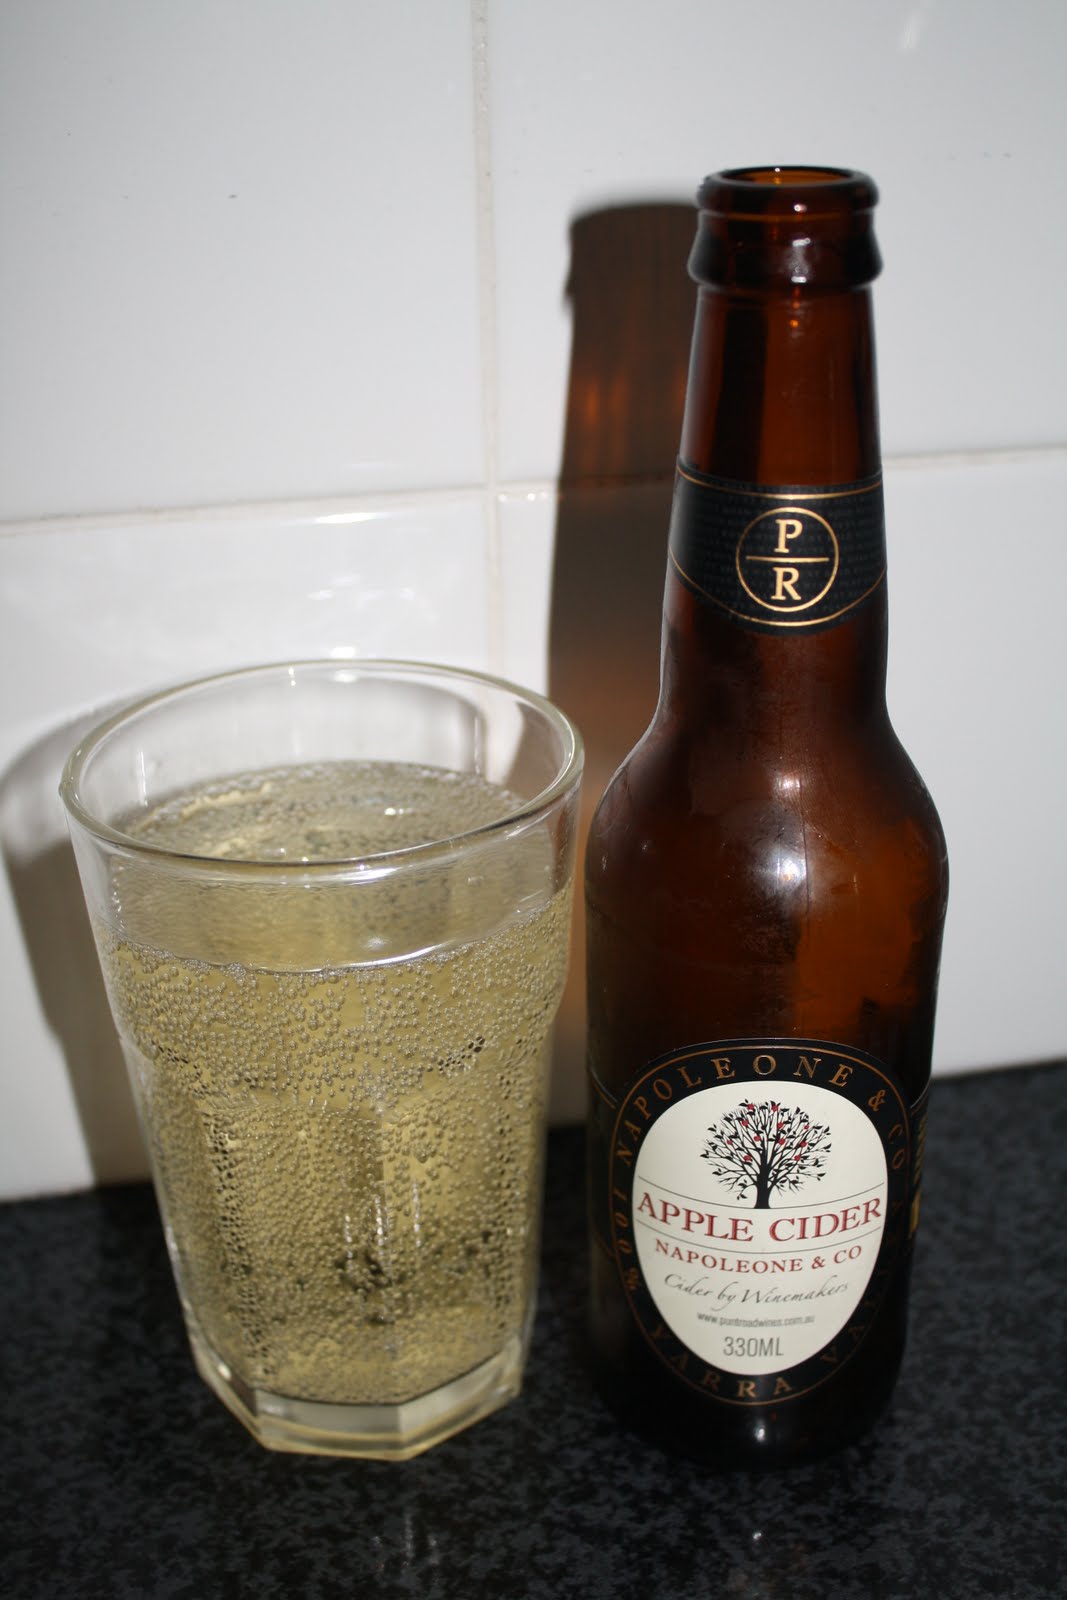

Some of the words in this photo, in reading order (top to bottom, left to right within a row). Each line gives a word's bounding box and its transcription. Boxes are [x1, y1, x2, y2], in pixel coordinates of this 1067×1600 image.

[774, 519, 803, 553] P
[771, 567, 801, 600] R
[616, 1055, 853, 1167] NAPOLEONE
[868, 1090, 886, 1112] &
[637, 1192, 754, 1242] APPLE
[769, 1197, 882, 1242] CIDER
[656, 1238, 803, 1274] NAPOLEONE
[812, 1256, 826, 1270] &
[833, 1245, 863, 1265] CO
[664, 1273, 713, 1297] Cider
[710, 1281, 739, 1311] by
[741, 1275, 849, 1304] Winemakers
[723, 1336, 784, 1357] 330ML
